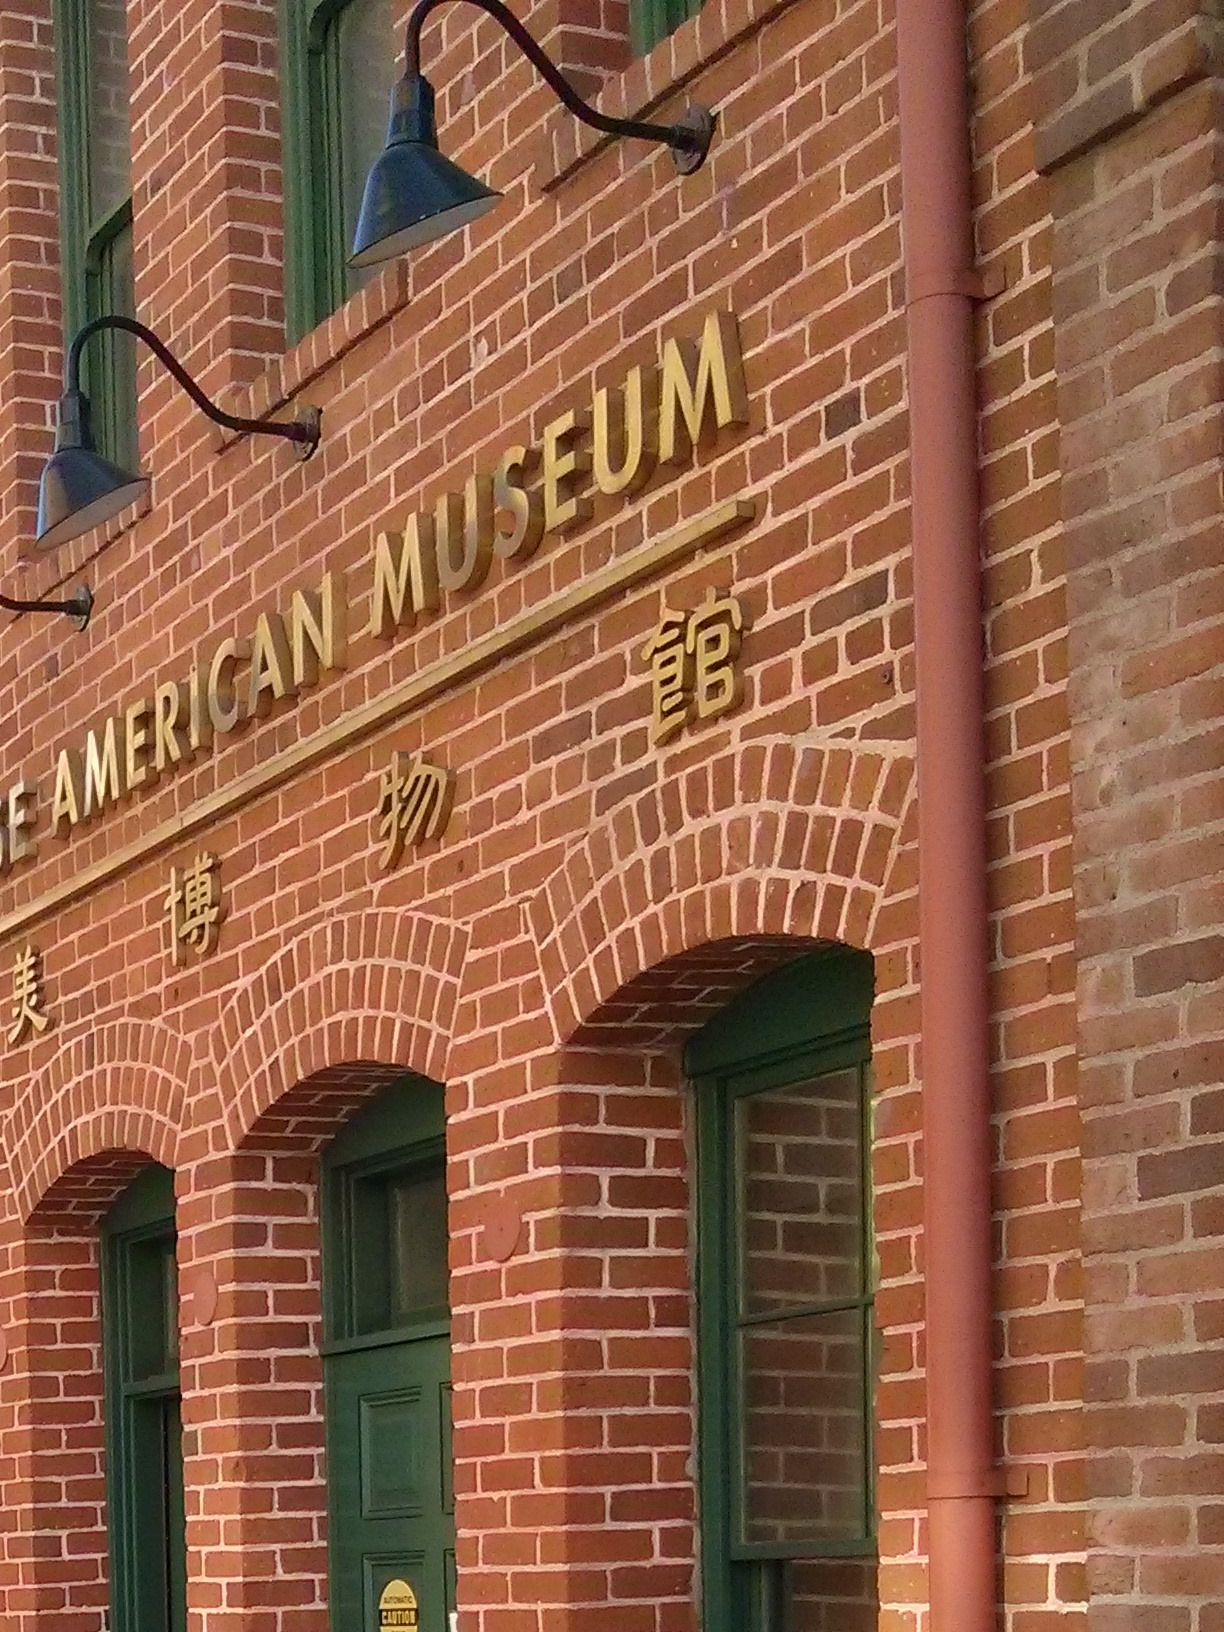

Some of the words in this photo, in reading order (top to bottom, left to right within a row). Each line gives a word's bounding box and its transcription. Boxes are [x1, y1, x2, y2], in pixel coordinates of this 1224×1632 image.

[51, 571, 344, 840] AMERICAN
[371, 310, 746, 641] MUSEUM
[381, 1610, 416, 1625] CAUTION
